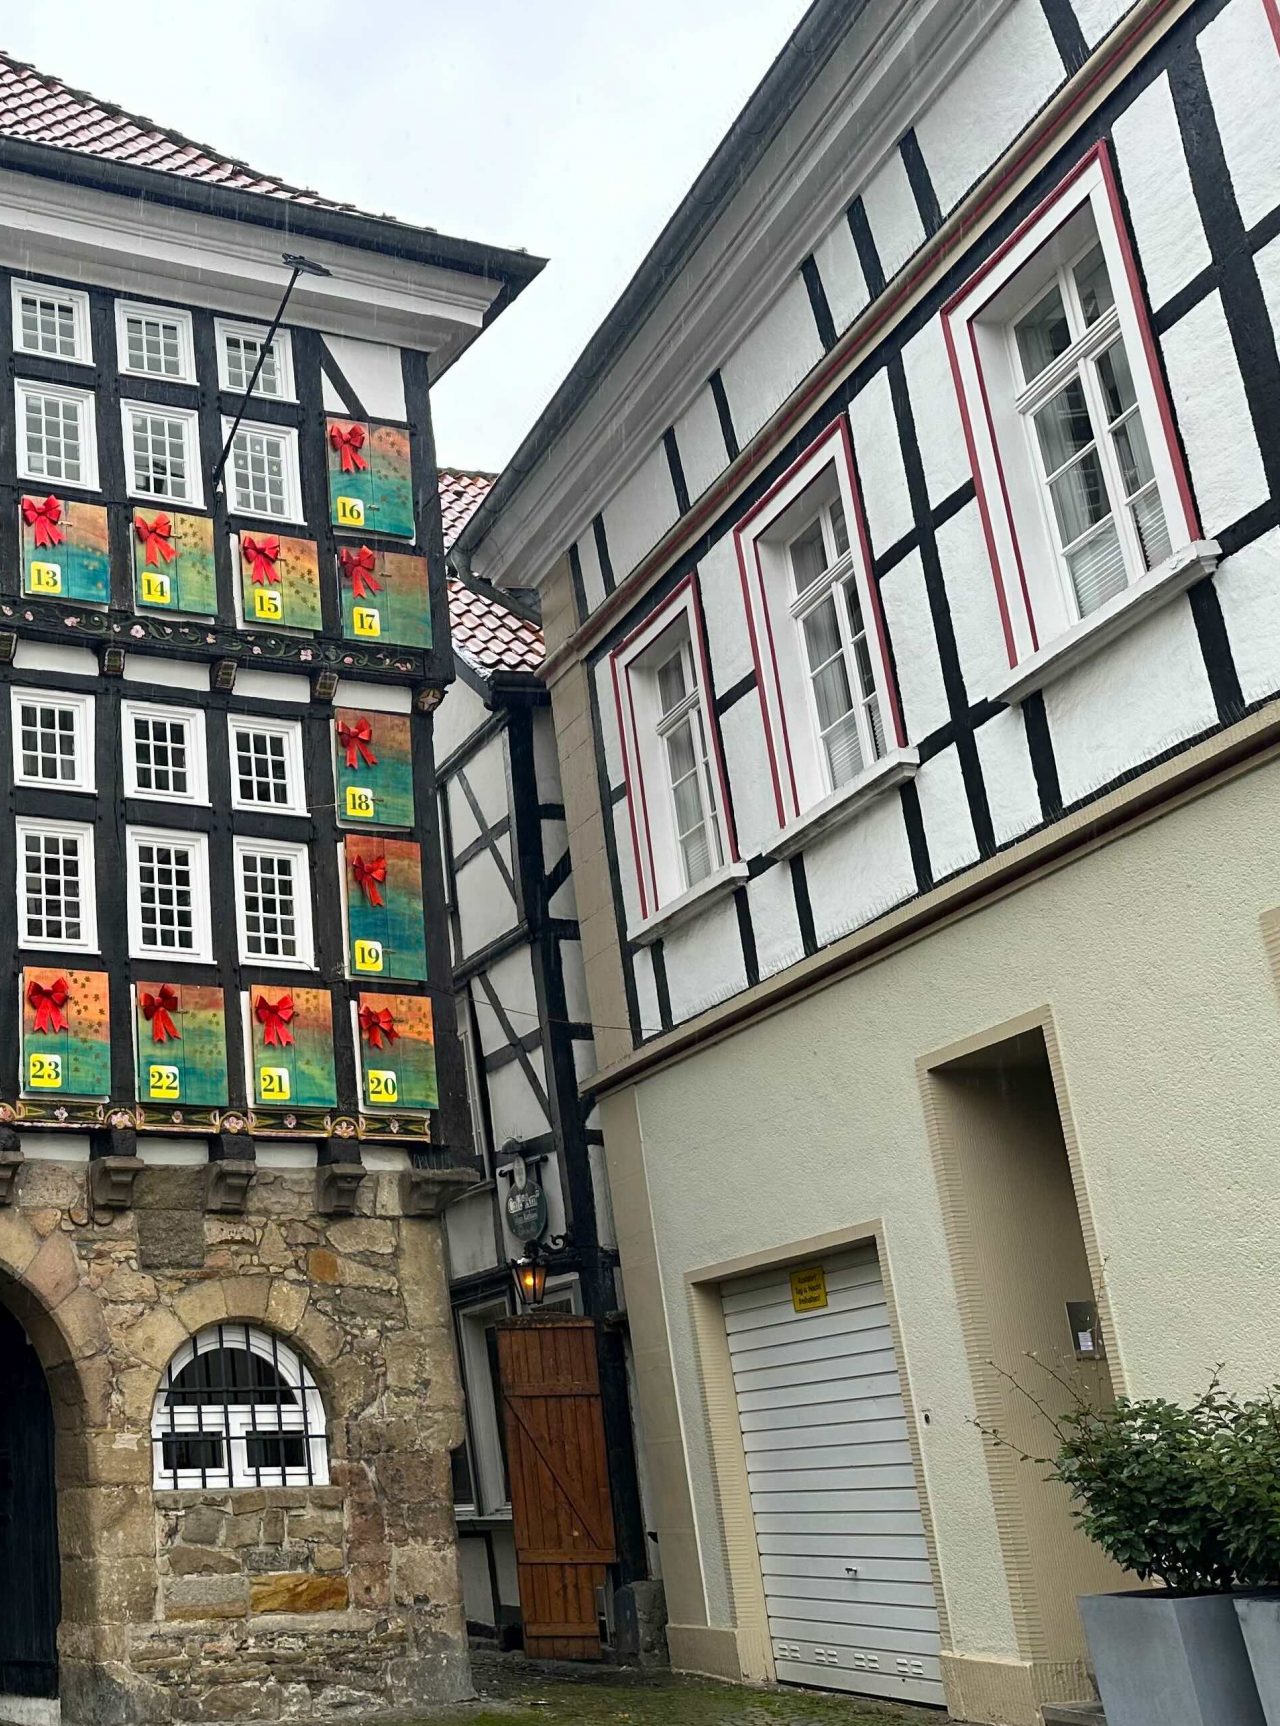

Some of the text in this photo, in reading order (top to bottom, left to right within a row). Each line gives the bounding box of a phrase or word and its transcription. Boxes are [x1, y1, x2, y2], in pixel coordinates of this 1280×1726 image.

[340, 502, 361, 520] 16
[34, 568, 58, 586] 13
[145, 579, 167, 597] 14
[258, 595, 279, 613] 15
[357, 613, 375, 630] 17
[350, 793, 370, 810] 18
[359, 947, 380, 965] 19
[32, 1060, 61, 1080] 23
[151, 1071, 178, 1091] 22
[262, 1074, 285, 1093] 21
[370, 1077, 397, 1096] 20
